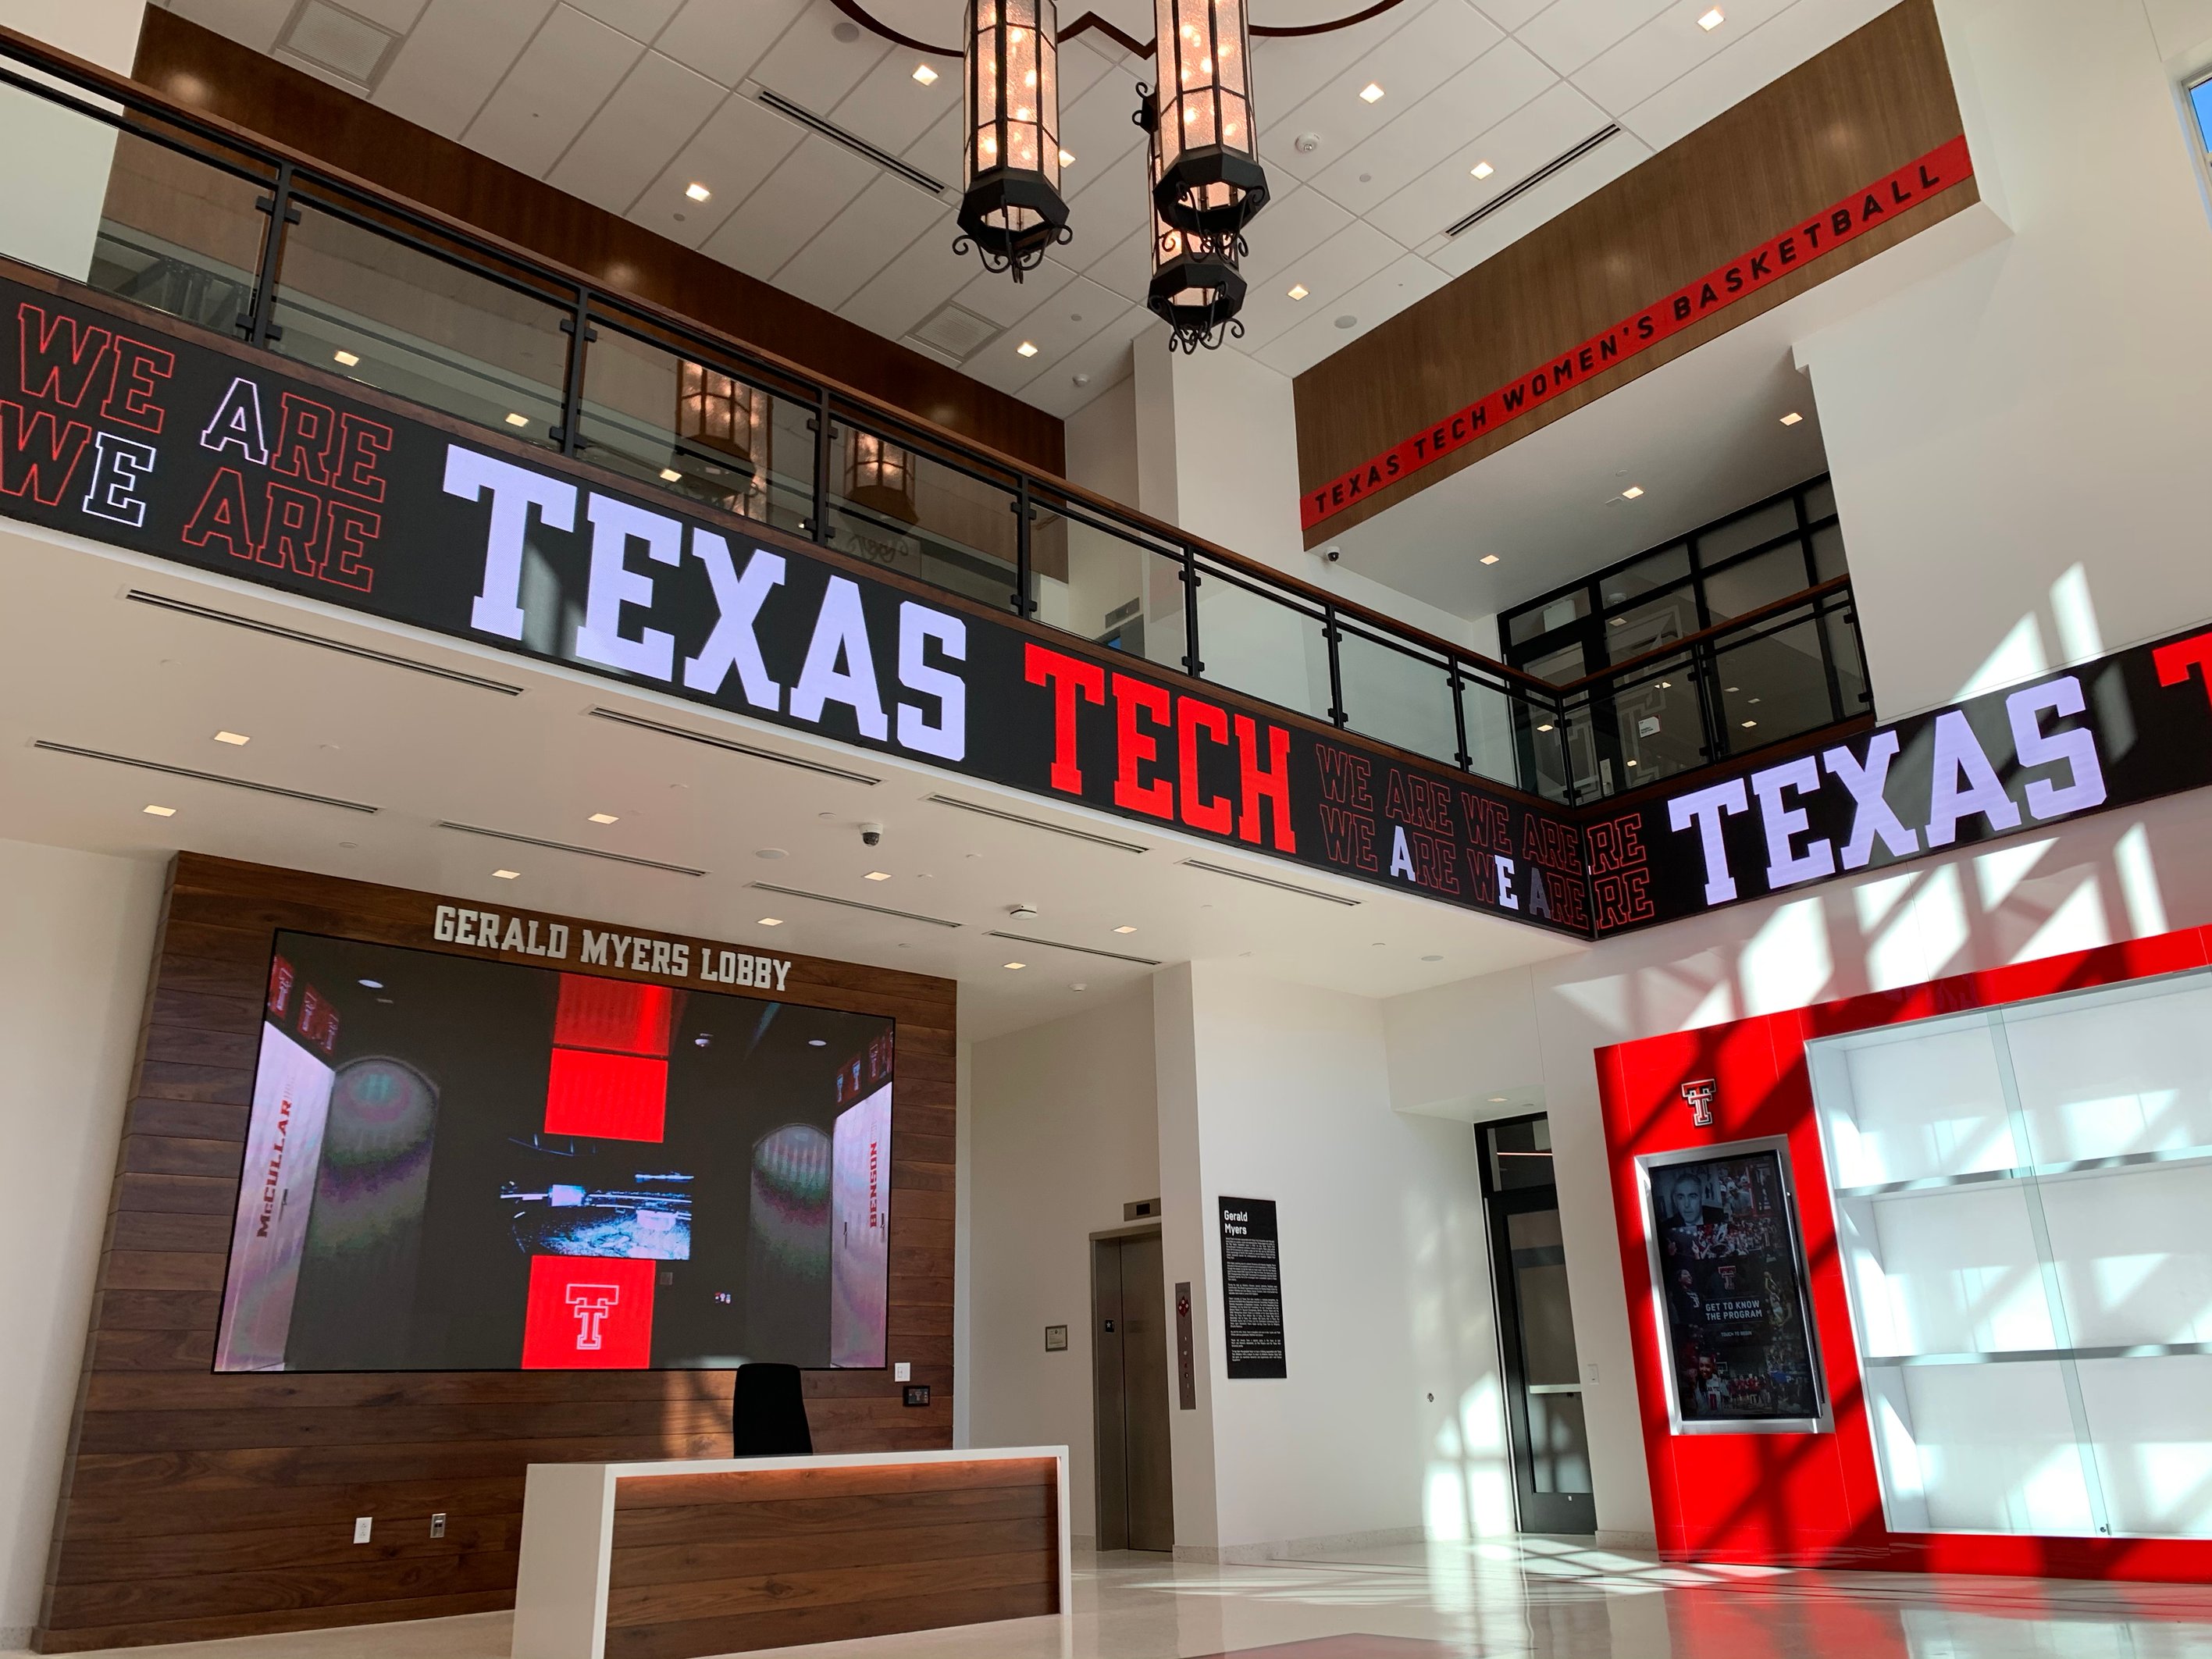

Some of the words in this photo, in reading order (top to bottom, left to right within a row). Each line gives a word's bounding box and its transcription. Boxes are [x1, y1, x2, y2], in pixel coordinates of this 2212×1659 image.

[1315, 454, 1400, 513] TEXAS
[1413, 405, 1487, 460] TECH
[1503, 315, 1655, 411] WOMEN'S
[1672, 165, 1940, 321] BASKETBALL
[18, 303, 175, 433] WE
[201, 378, 393, 503] ARE
[0, 400, 156, 528] WE
[182, 467, 381, 593] ARE
[443, 443, 967, 762] TEXAS
[1024, 642, 1296, 854] TECH
[1316, 743, 1373, 812] WE
[1385, 768, 1454, 837] ARE
[1461, 792, 1512, 853] WE
[1522, 813, 1583, 876] ARE
[1587, 813, 1647, 875] RE
[1667, 675, 2107, 906] TEXAS
[1320, 803, 1378, 872] WE
[1390, 825, 1459, 895] ARE
[1466, 847, 1519, 910] WE
[1529, 867, 1590, 931] ARE
[1594, 867, 1655, 931] RE
[433, 905, 569, 960] GERALD
[580, 929, 689, 977] MYERS
[700, 948, 792, 991] LOBBY
[1224, 1210, 1248, 1222] Gerald
[1224, 1223, 1247, 1236] Myers
[1705, 1302, 1720, 1312] GET
[1722, 1301, 1733, 1311] TO
[1735, 1300, 1760, 1309] KNOW
[1705, 1312, 1722, 1320] THE
[1723, 1309, 1763, 1319] PROGRAM
